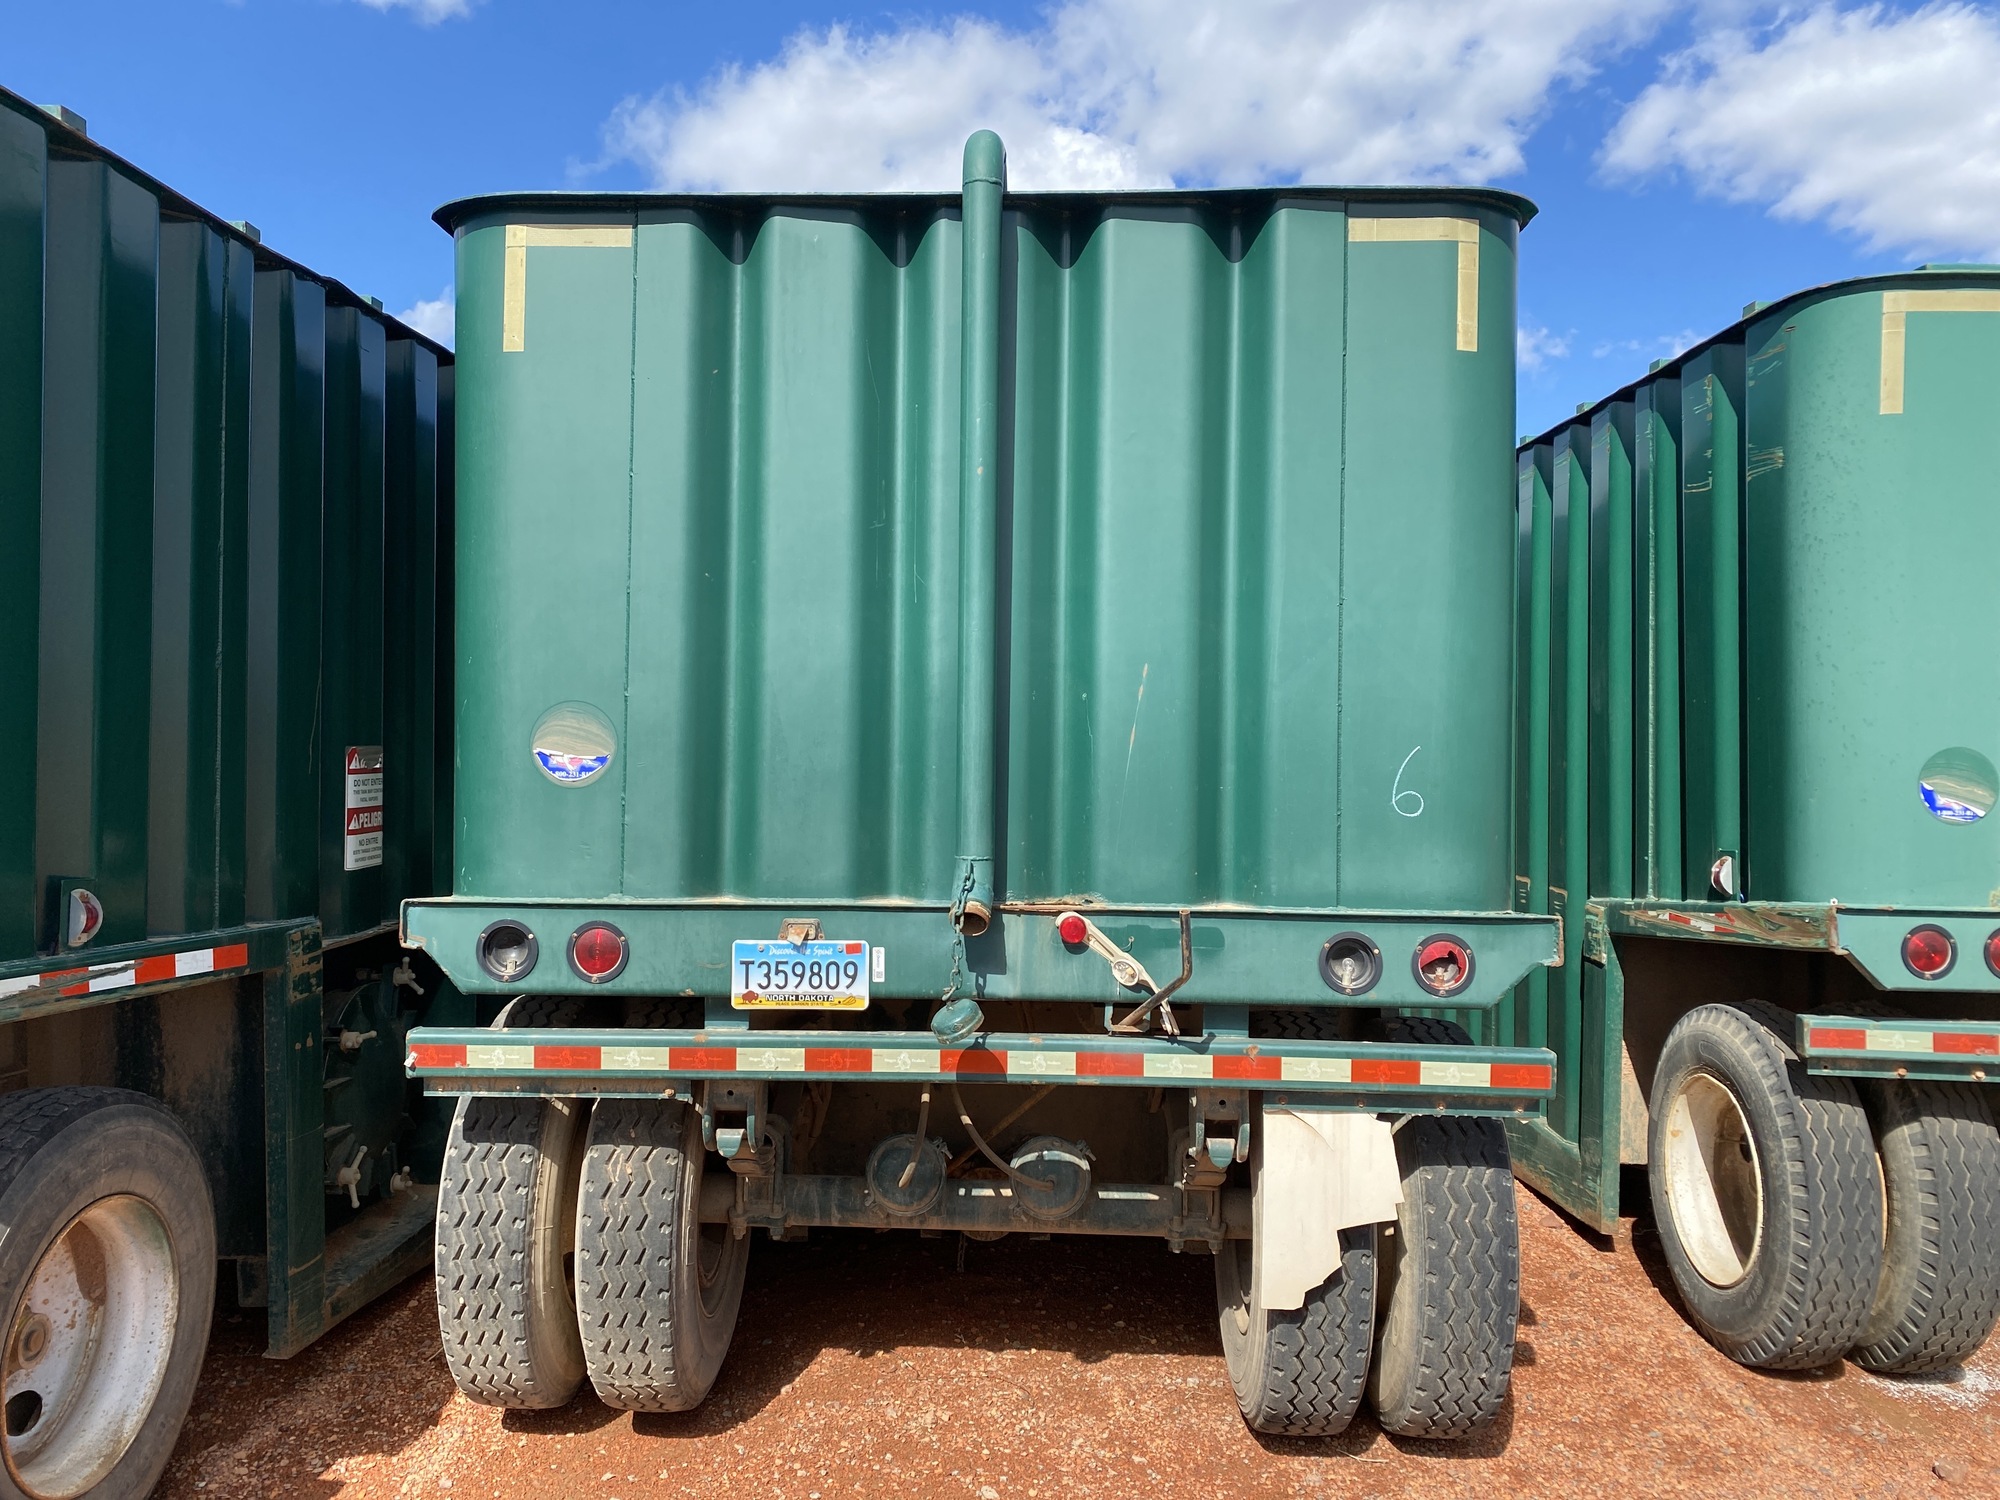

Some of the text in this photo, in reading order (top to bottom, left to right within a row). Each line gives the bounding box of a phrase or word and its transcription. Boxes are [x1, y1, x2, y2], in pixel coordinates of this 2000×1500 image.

[353, 779, 361, 787] DO
[1392, 745, 1424, 817] 6
[812, 945, 833, 957] Spirit
[739, 960, 858, 990] T359809
[765, 994, 835, 1003] NORTH DAKOTA
